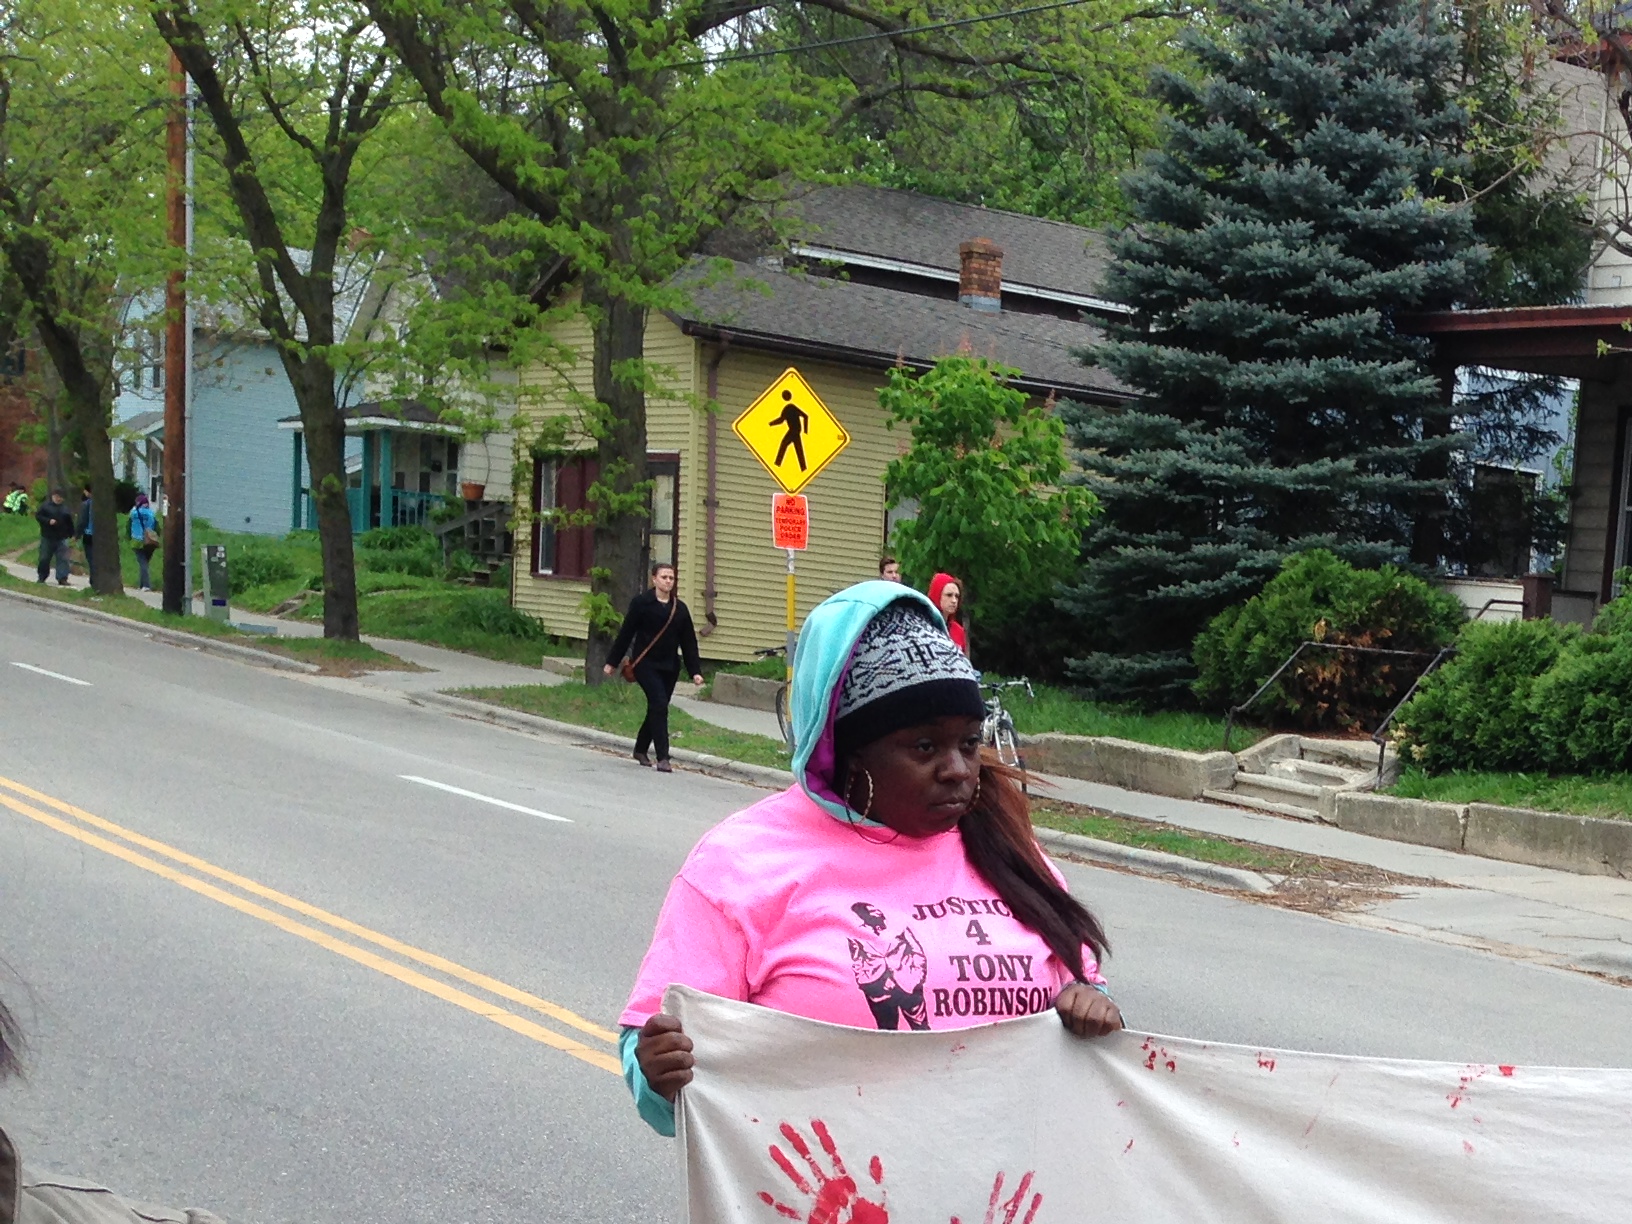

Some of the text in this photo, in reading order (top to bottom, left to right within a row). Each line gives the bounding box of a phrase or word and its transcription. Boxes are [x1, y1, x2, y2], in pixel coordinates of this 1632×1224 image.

[912, 896, 1014, 921] JUSTIC
[965, 919, 992, 945] 4
[949, 954, 1033, 982] TONY
[933, 987, 1052, 1017] ROBINSON
